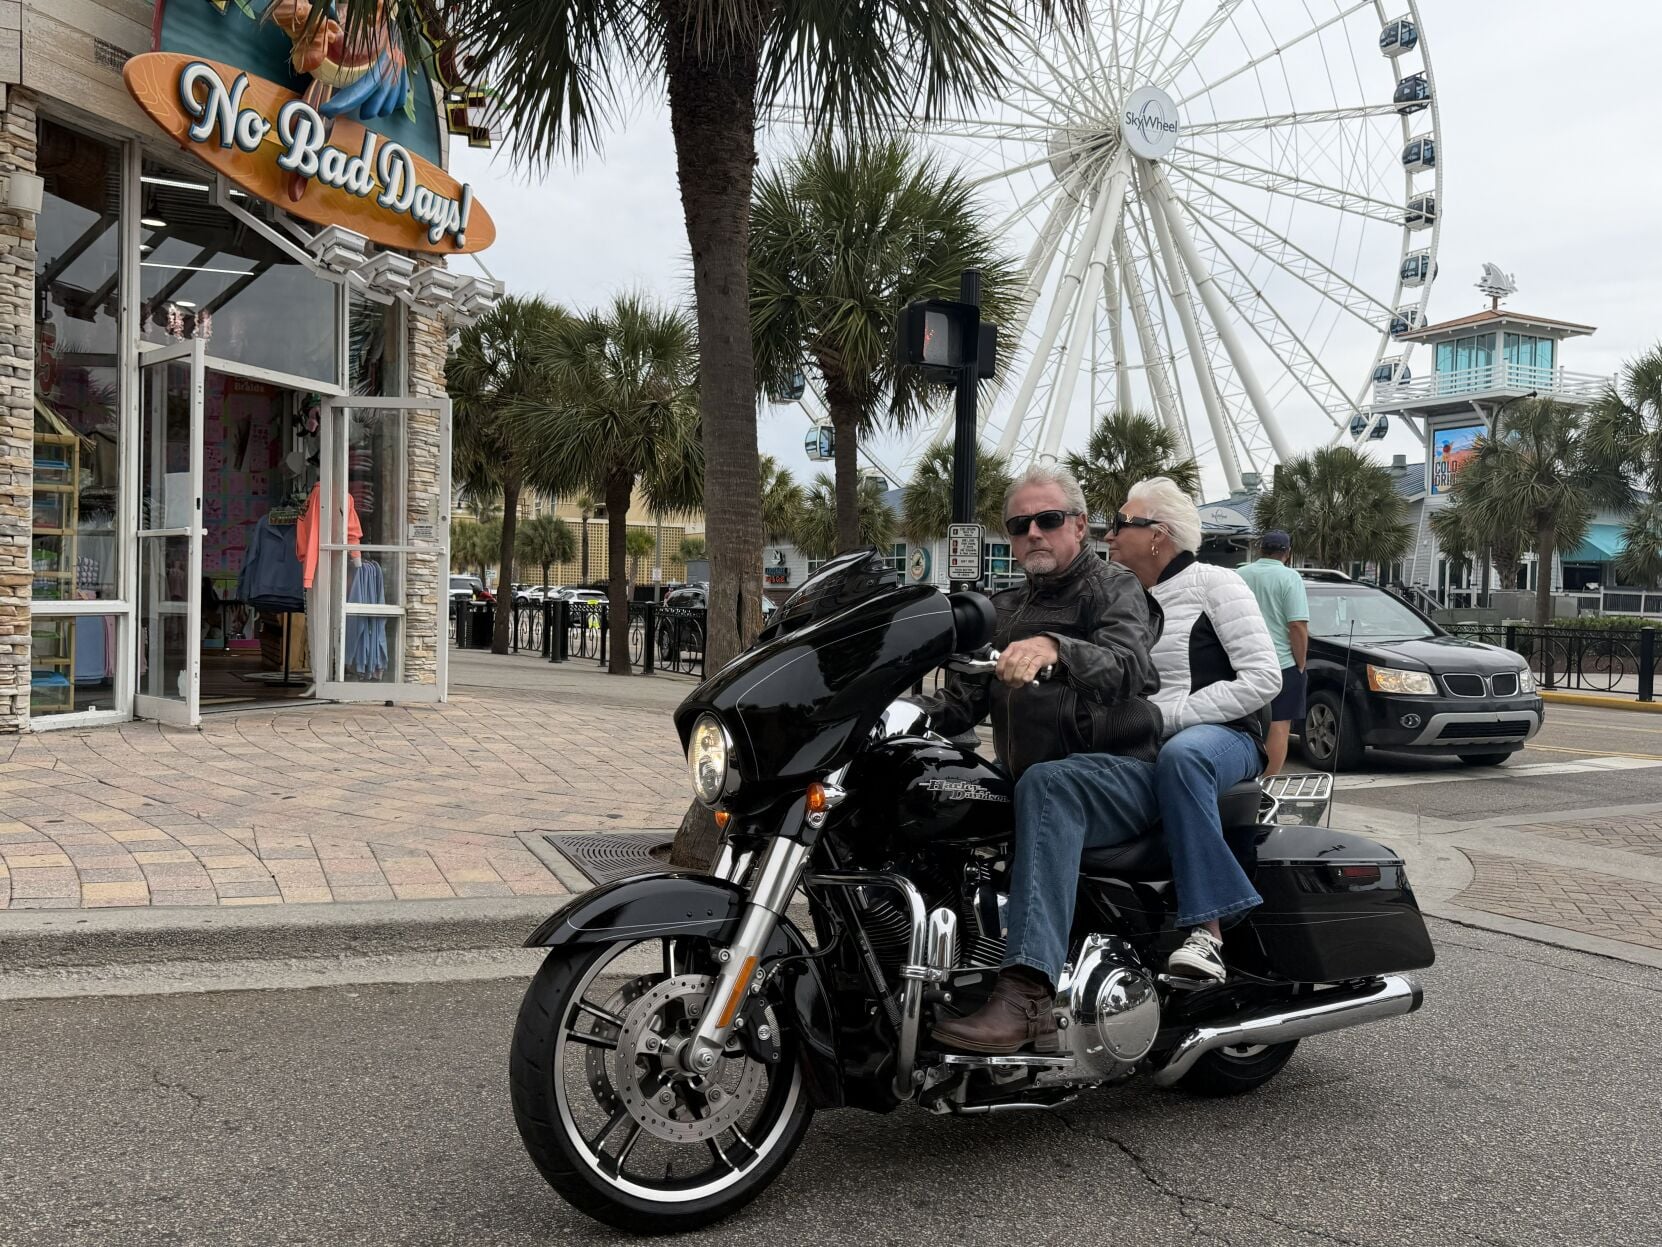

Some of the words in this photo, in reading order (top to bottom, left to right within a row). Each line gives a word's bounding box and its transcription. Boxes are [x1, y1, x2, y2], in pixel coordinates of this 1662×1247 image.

[1125, 111, 1178, 133] SkyWheel
[180, 61, 272, 150] No
[277, 100, 375, 197] Bad
[377, 141, 474, 248] Days!
[1435, 460, 1458, 474] COLD
